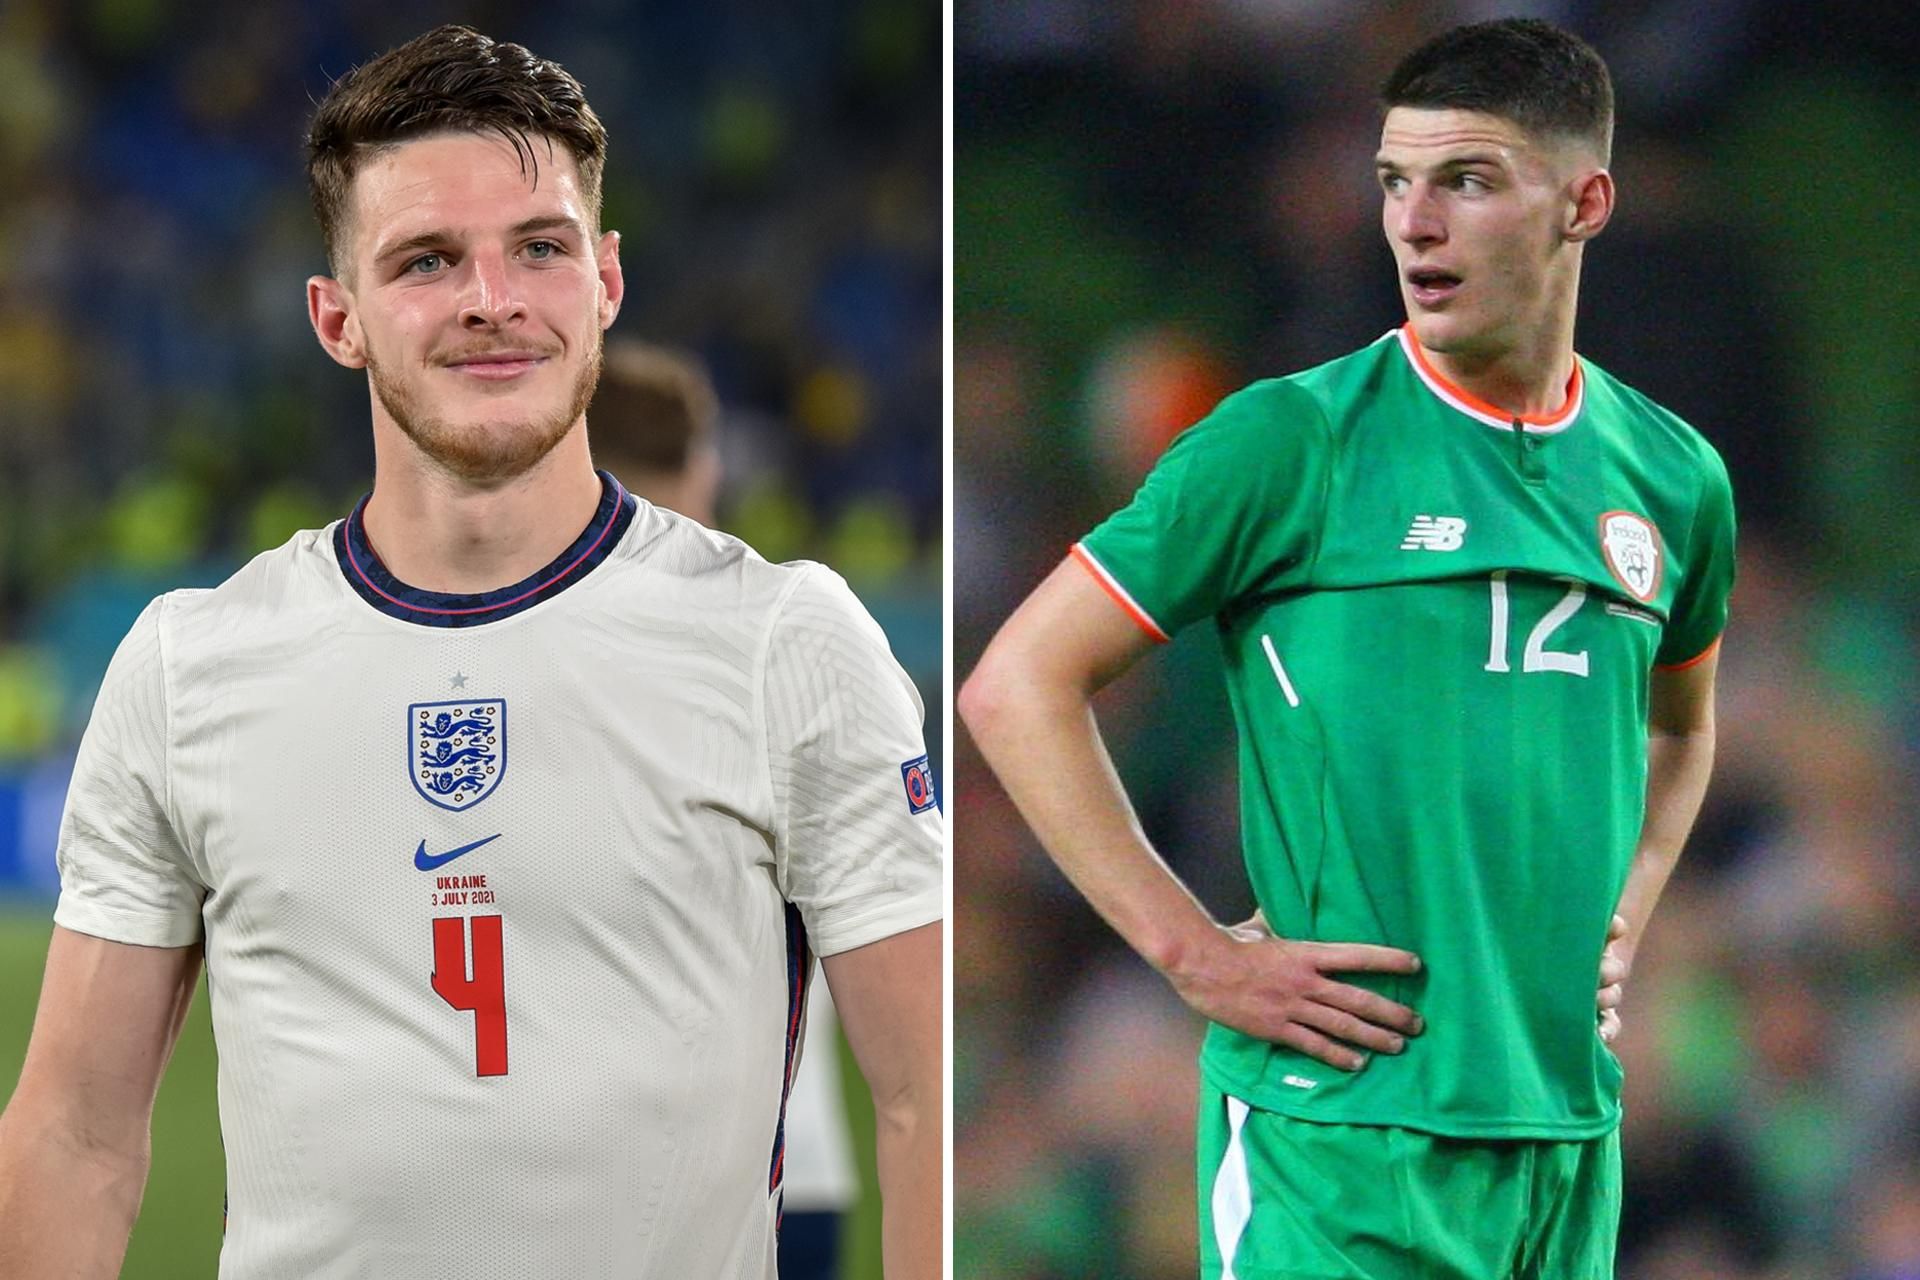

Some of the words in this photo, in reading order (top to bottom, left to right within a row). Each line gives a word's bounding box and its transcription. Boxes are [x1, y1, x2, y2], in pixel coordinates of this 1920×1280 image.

[1484, 568, 1589, 677] 12
[431, 893, 438, 906] 3
[441, 891, 468, 906] JULY
[471, 890, 495, 905] 2021
[436, 874, 487, 890] UKRAINE
[431, 915, 509, 1078] 4
